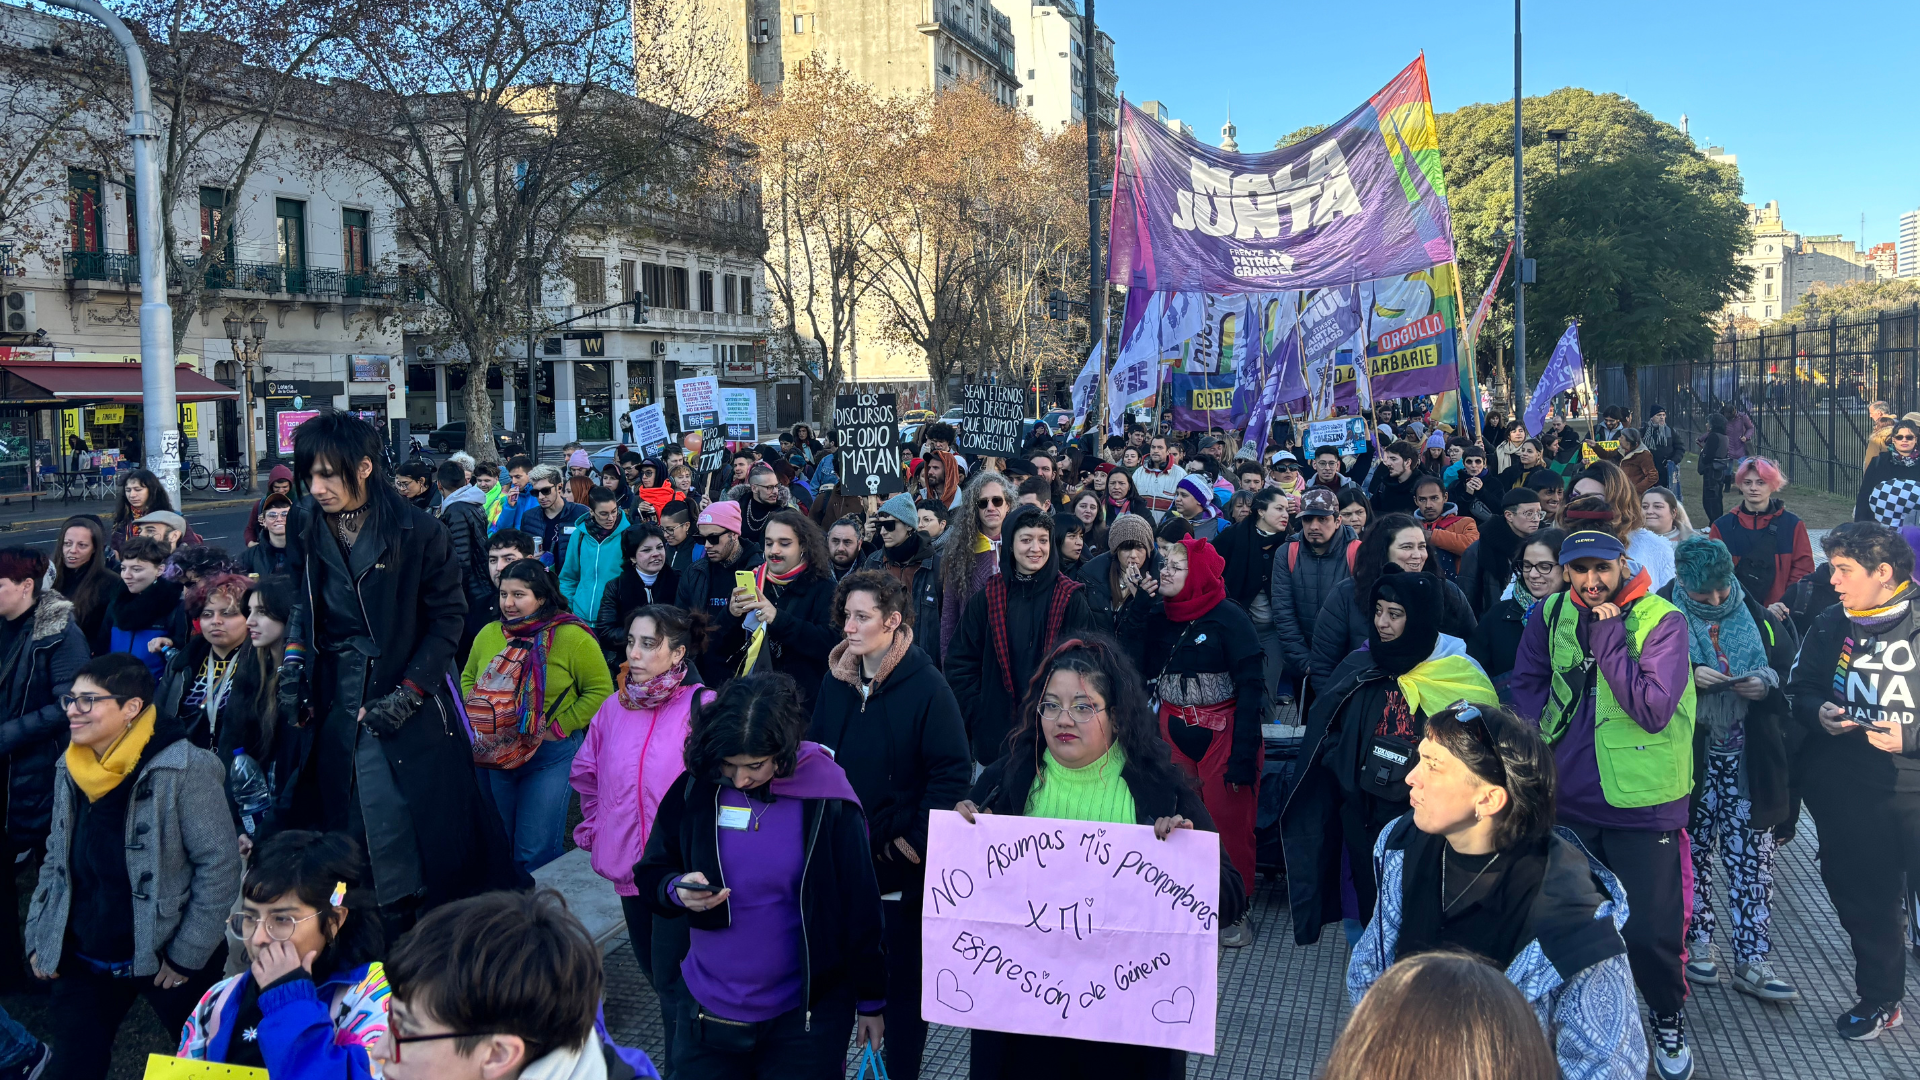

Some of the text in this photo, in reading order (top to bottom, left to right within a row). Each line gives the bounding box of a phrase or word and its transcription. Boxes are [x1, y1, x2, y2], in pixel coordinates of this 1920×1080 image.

[1173, 166, 1362, 239] JUNTA
[1229, 248, 1264, 257] FRENTE
[1233, 256, 1280, 267] PATRIA
[1233, 265, 1286, 277] GRANDE
[1381, 316, 1442, 350] ORGULLO
[584, 338, 602, 353] W
[1371, 348, 1434, 376] ARBARIE
[857, 393, 879, 406] LOS
[964, 384, 988, 399] SEAN
[989, 385, 1024, 404] ETERNOS
[836, 405, 894, 426] DISCURSOS
[963, 399, 1023, 421] LOS DERECHOS
[838, 425, 890, 448] DE ODIO
[963, 416, 1018, 438] QUE SUPIMOS
[963, 433, 1015, 454] CONSEGUIR
[841, 447, 900, 485] MATAN
[1853, 639, 1916, 672] ZO
[1847, 671, 1916, 708] NA
[931, 868, 974, 914] NO
[1079, 980, 1106, 1009] de
[1114, 952, 1171, 991] Género
